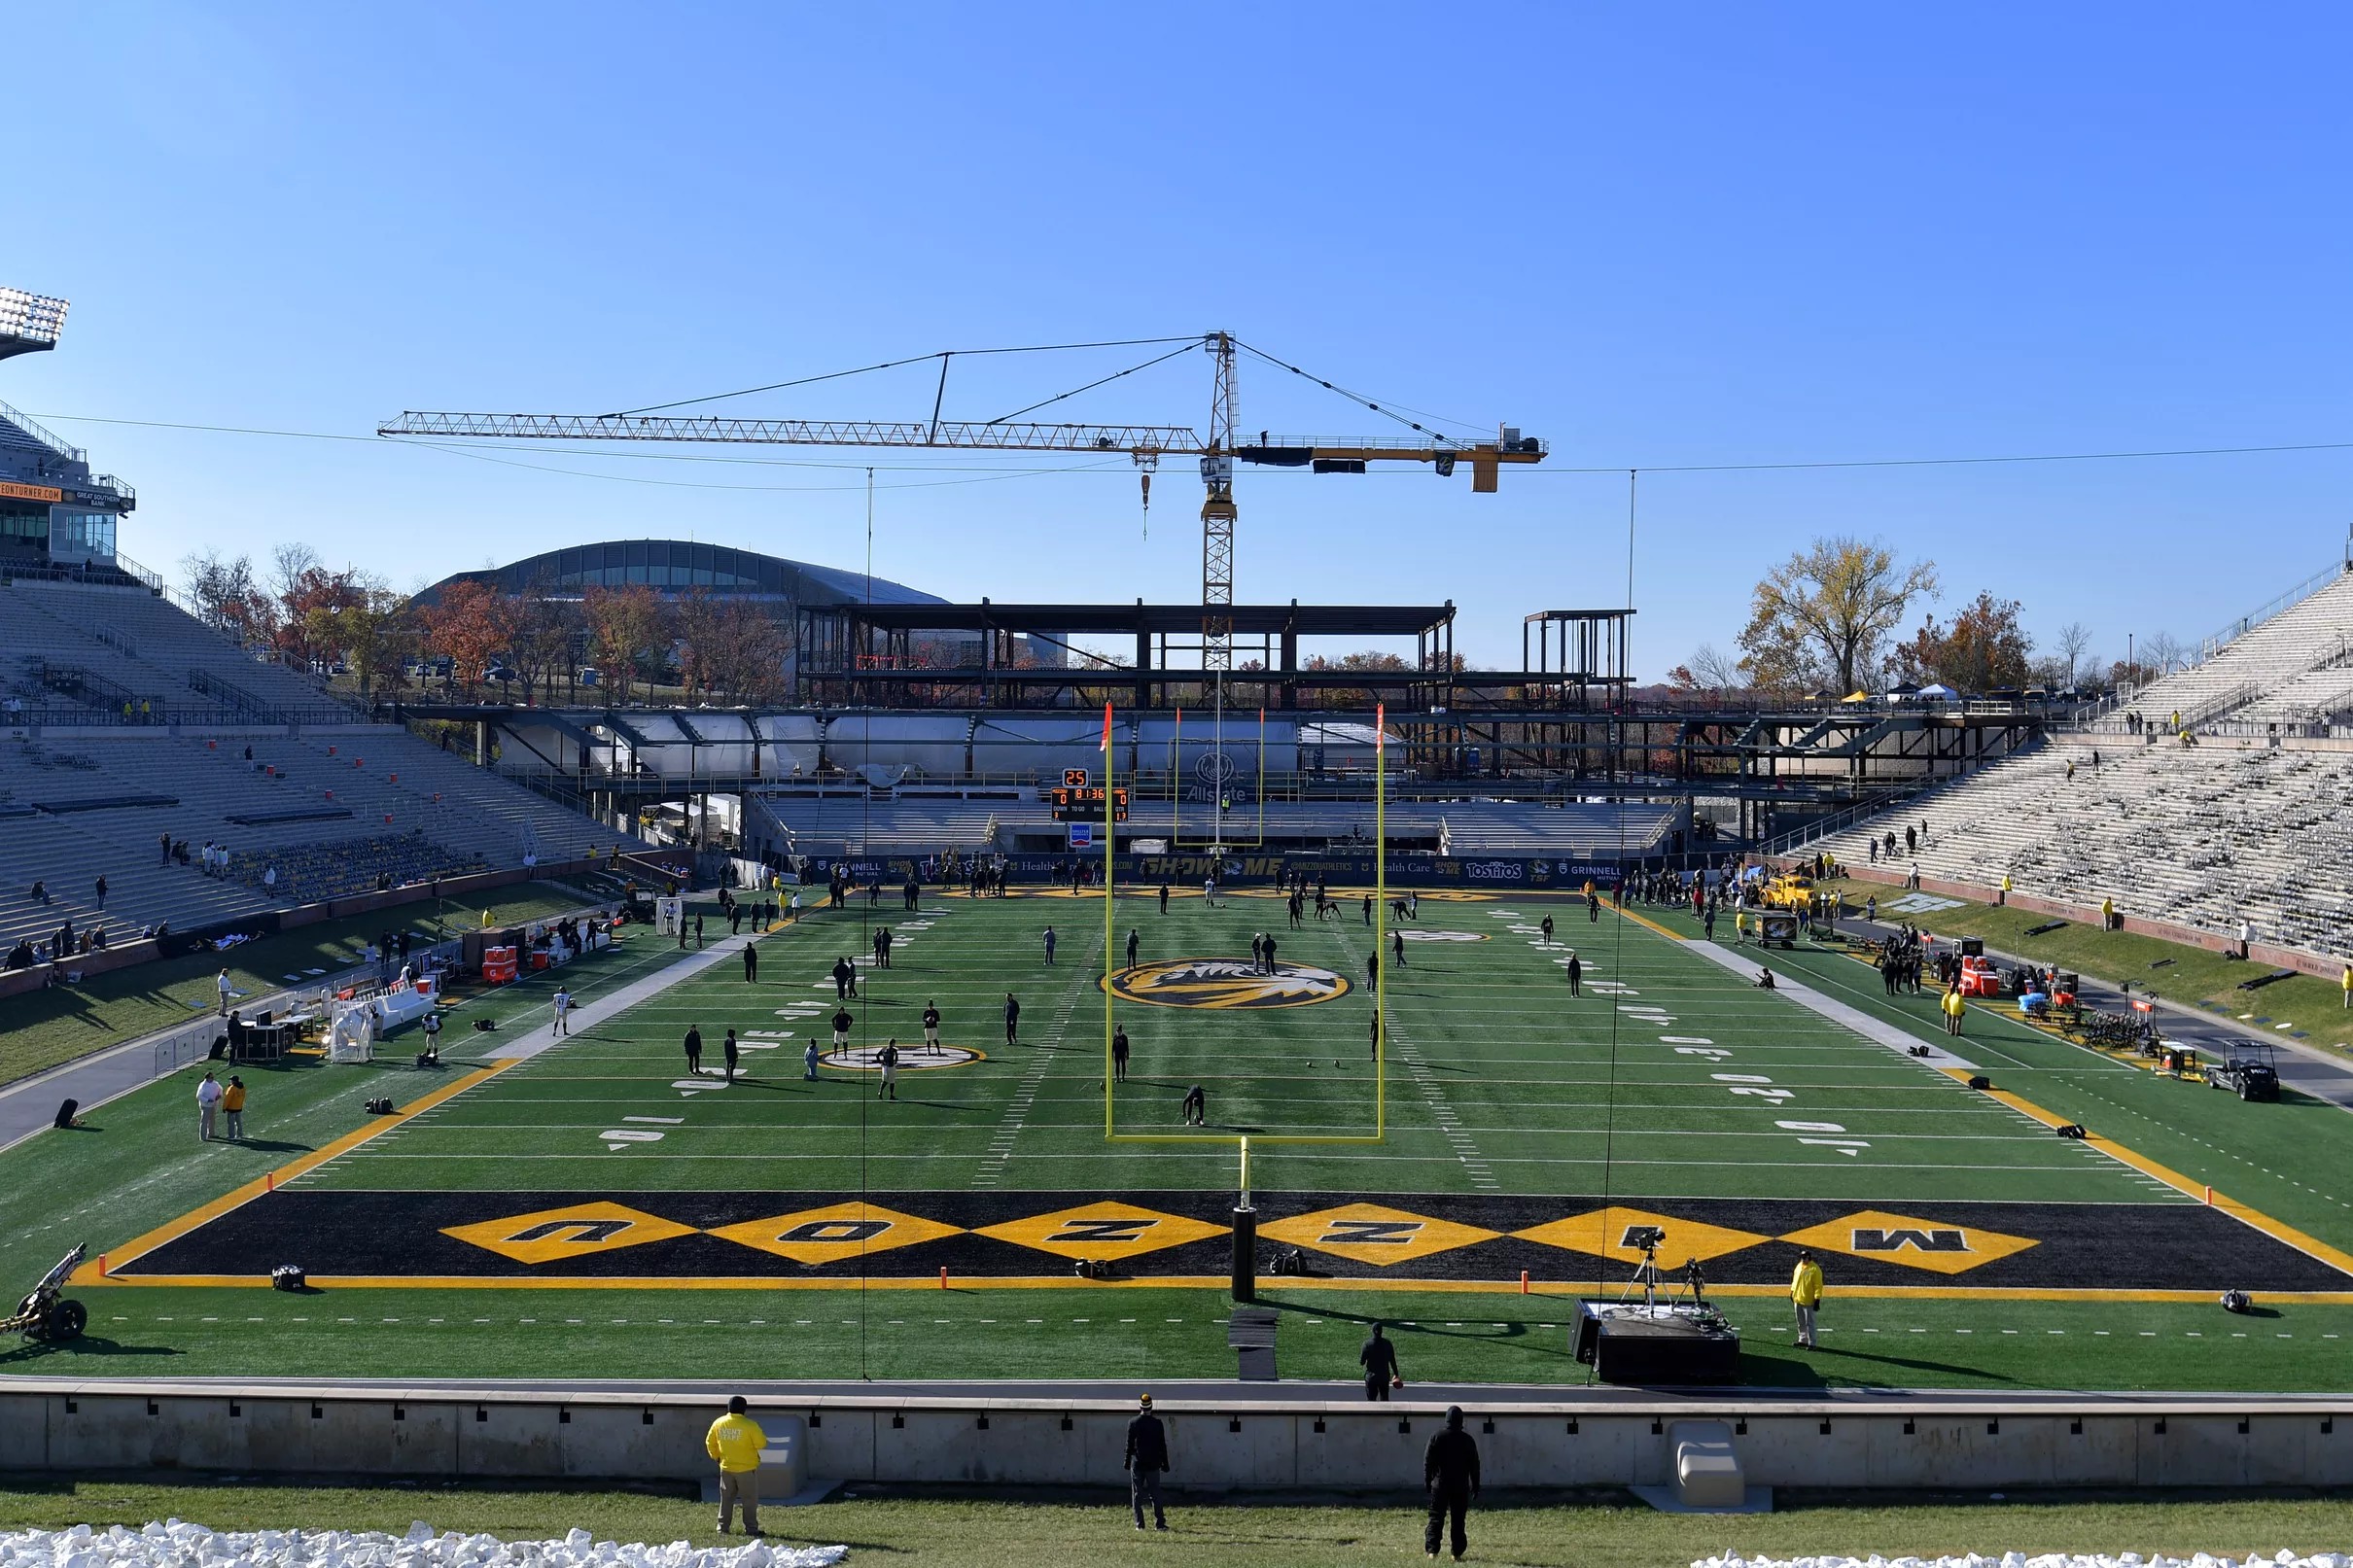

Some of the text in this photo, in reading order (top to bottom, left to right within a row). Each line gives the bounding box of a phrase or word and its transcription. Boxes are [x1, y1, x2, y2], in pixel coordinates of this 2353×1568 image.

[77, 491, 121, 504] GREAT SOUTHERN
[1067, 771, 1085, 785] 25
[1186, 784, 1246, 802] Allsate
[1060, 794, 1068, 805] 0
[1120, 794, 1127, 805] 0
[1145, 857, 1284, 876] SHOW ME
[1407, 862, 1430, 872] Care
[1571, 866, 1622, 876] GRINNELL
